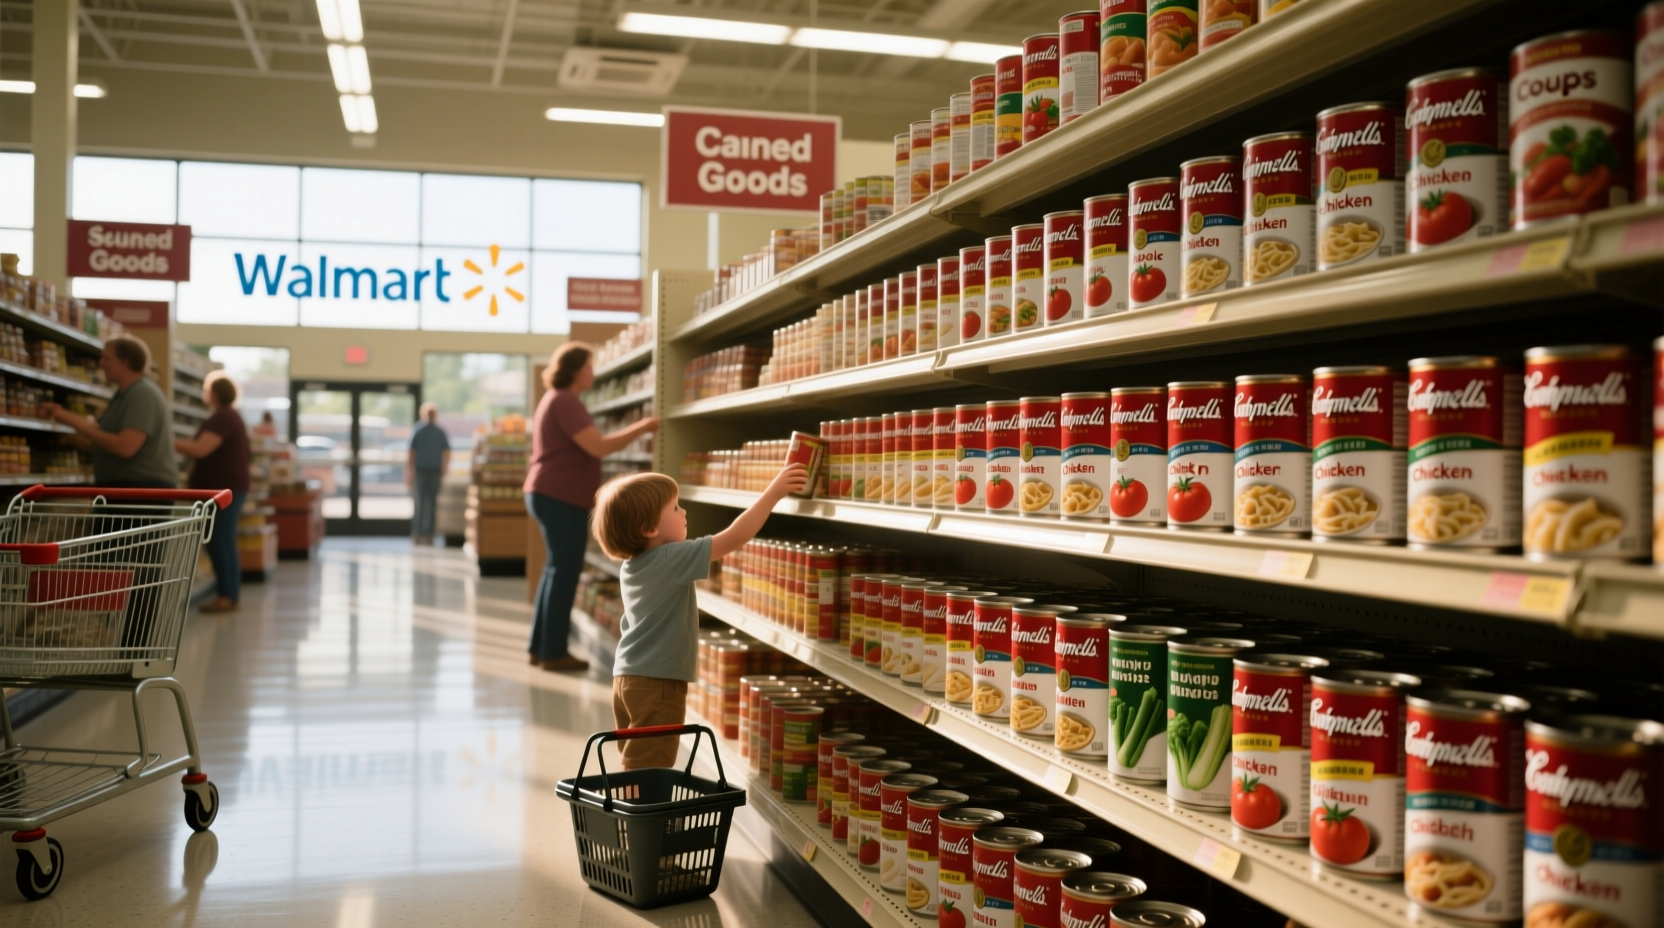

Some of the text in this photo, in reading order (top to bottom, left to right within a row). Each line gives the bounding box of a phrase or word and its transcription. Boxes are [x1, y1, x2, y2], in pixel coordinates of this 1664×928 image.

[1517, 69, 1597, 102] Coups
[697, 160, 808, 198] Goods
[88, 248, 170, 274] Goods
[234, 253, 451, 303] Walmart
[1315, 462, 1365, 480] Chicken
[1413, 462, 1472, 481] Chicken
